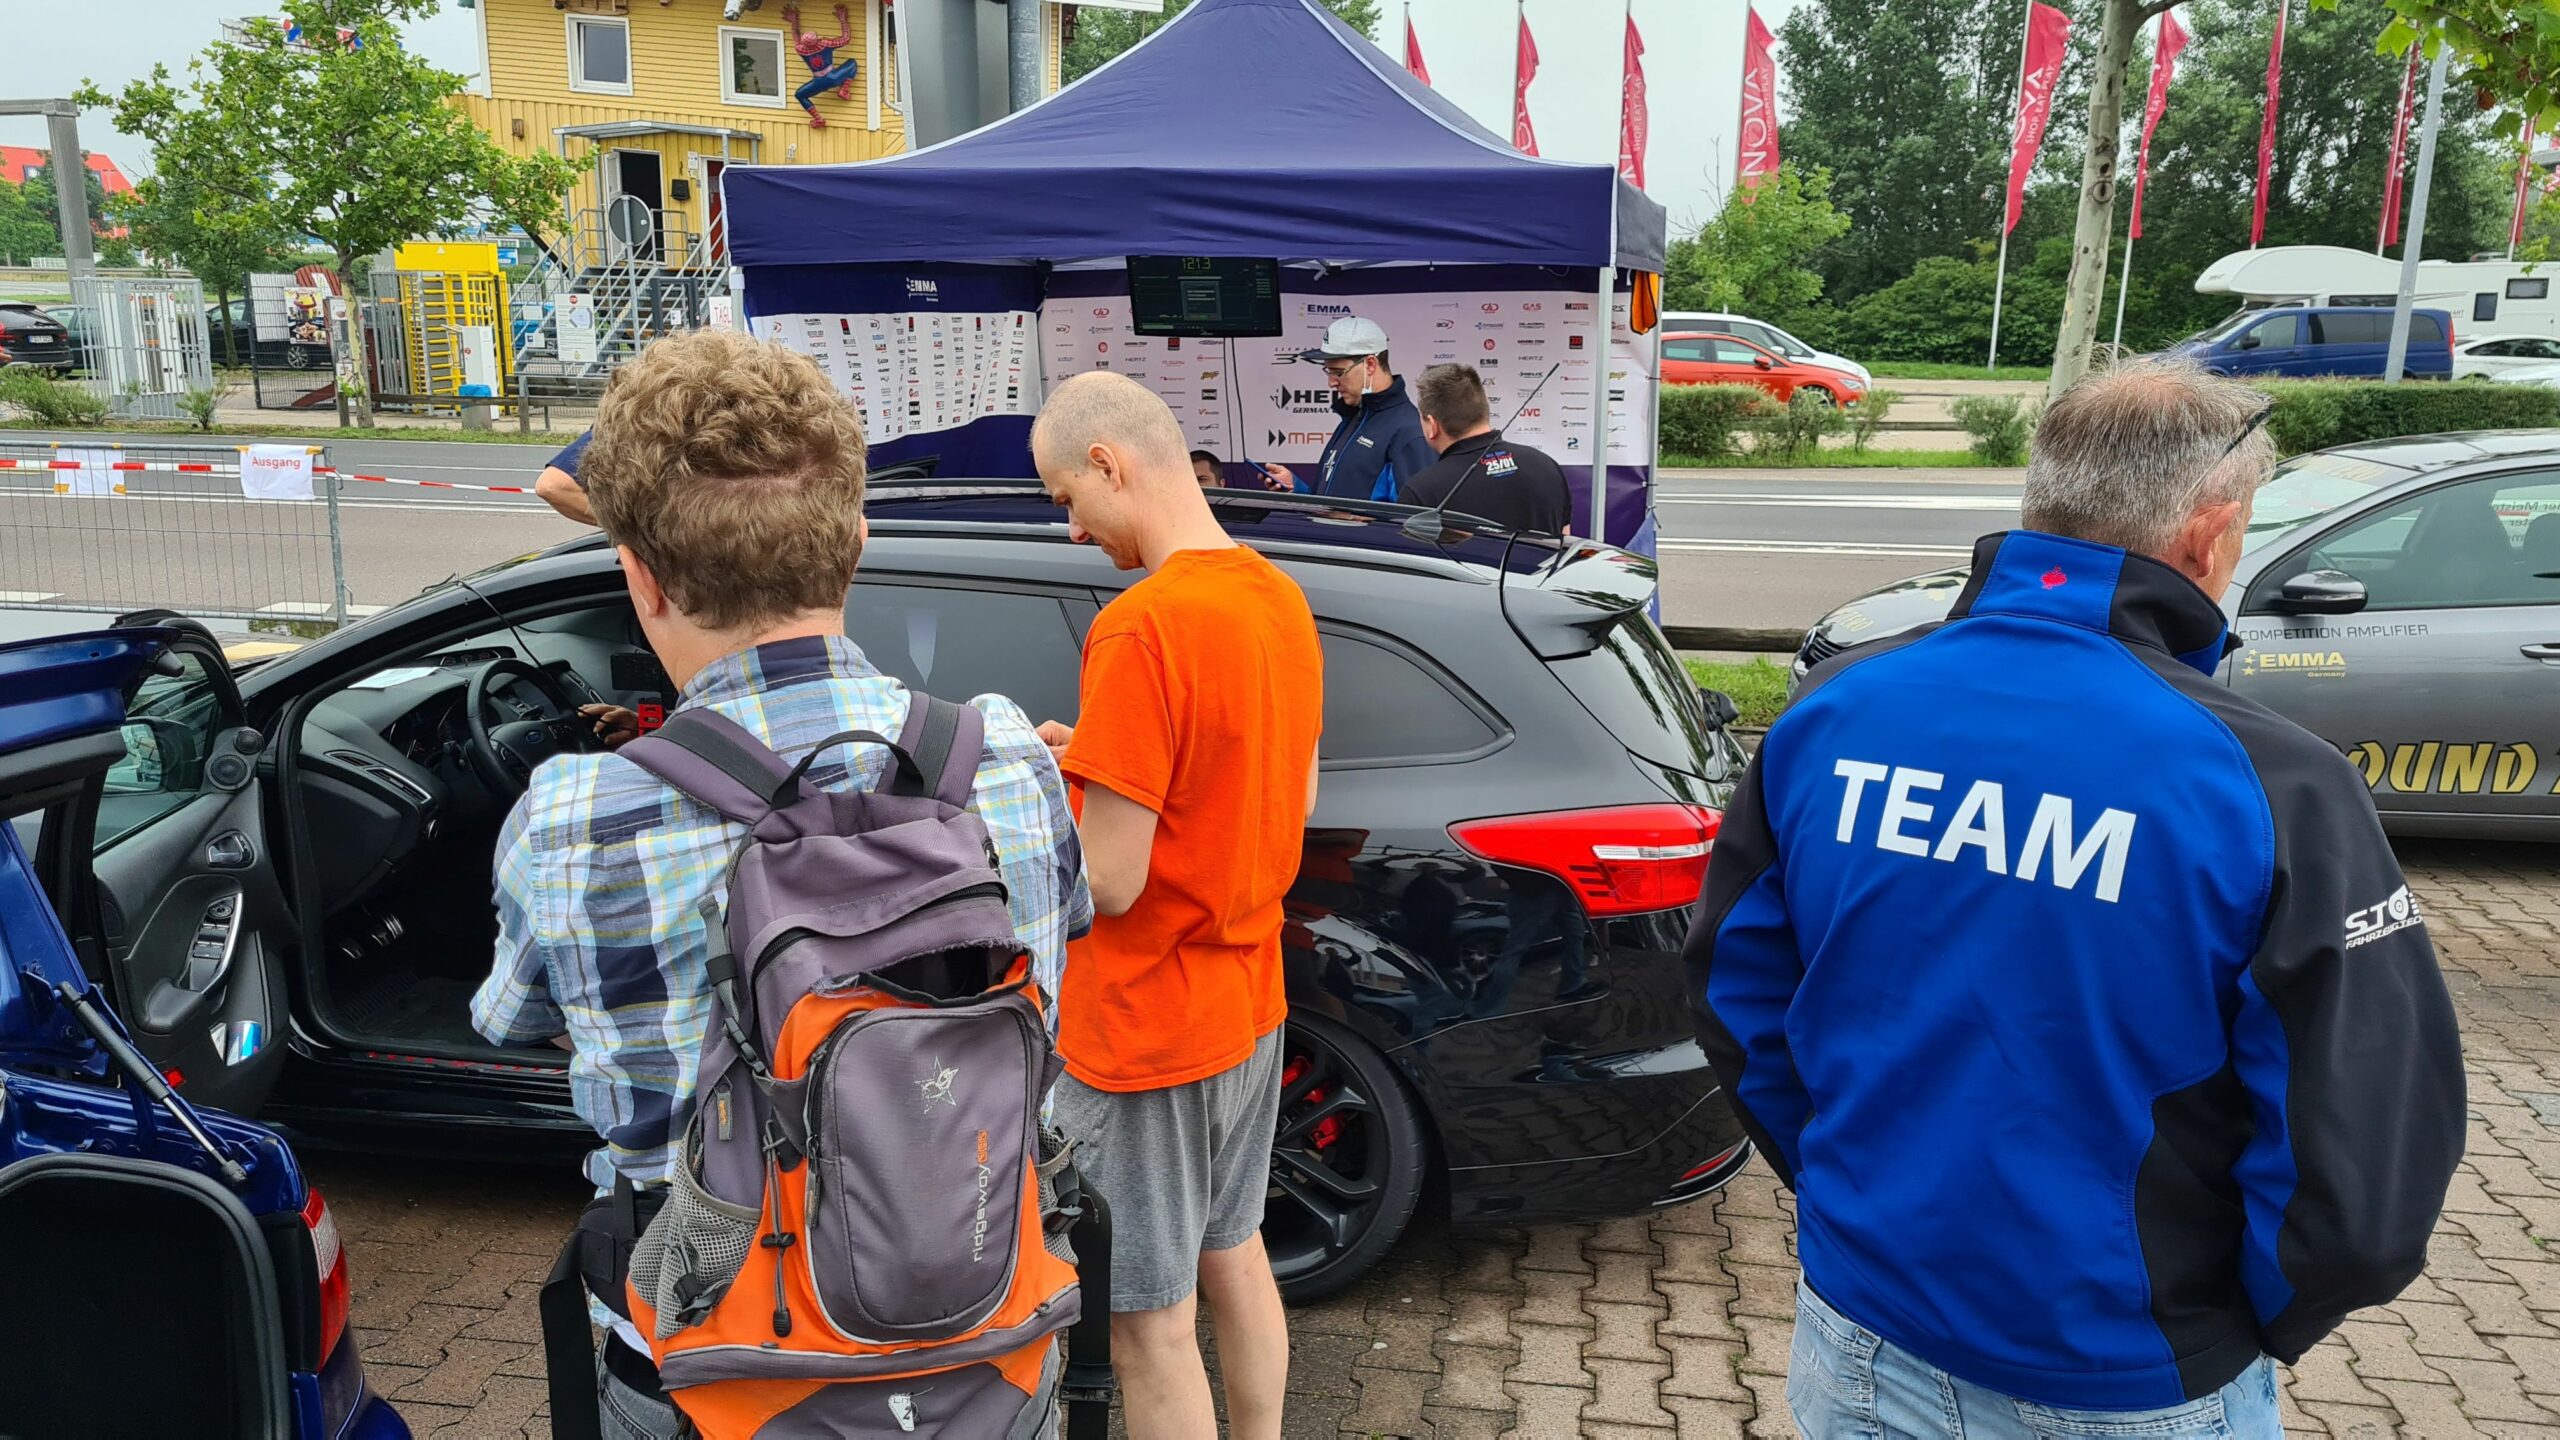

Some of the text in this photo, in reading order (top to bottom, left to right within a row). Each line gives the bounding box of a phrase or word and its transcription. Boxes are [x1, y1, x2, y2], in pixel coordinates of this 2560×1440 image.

[1307, 304, 1351, 313] EMMA
[1519, 408, 1541, 417] JVC
[251, 456, 302, 470] Ausgang
[1486, 457, 1516, 472] 25/01
[2239, 624, 2429, 642] COMPETITION AMPLIFIER
[2260, 652, 2346, 668] EMMA
[2346, 740, 2539, 794] OUND
[1833, 758, 2137, 903] TEAM
[972, 1164, 991, 1262] ridgeway
